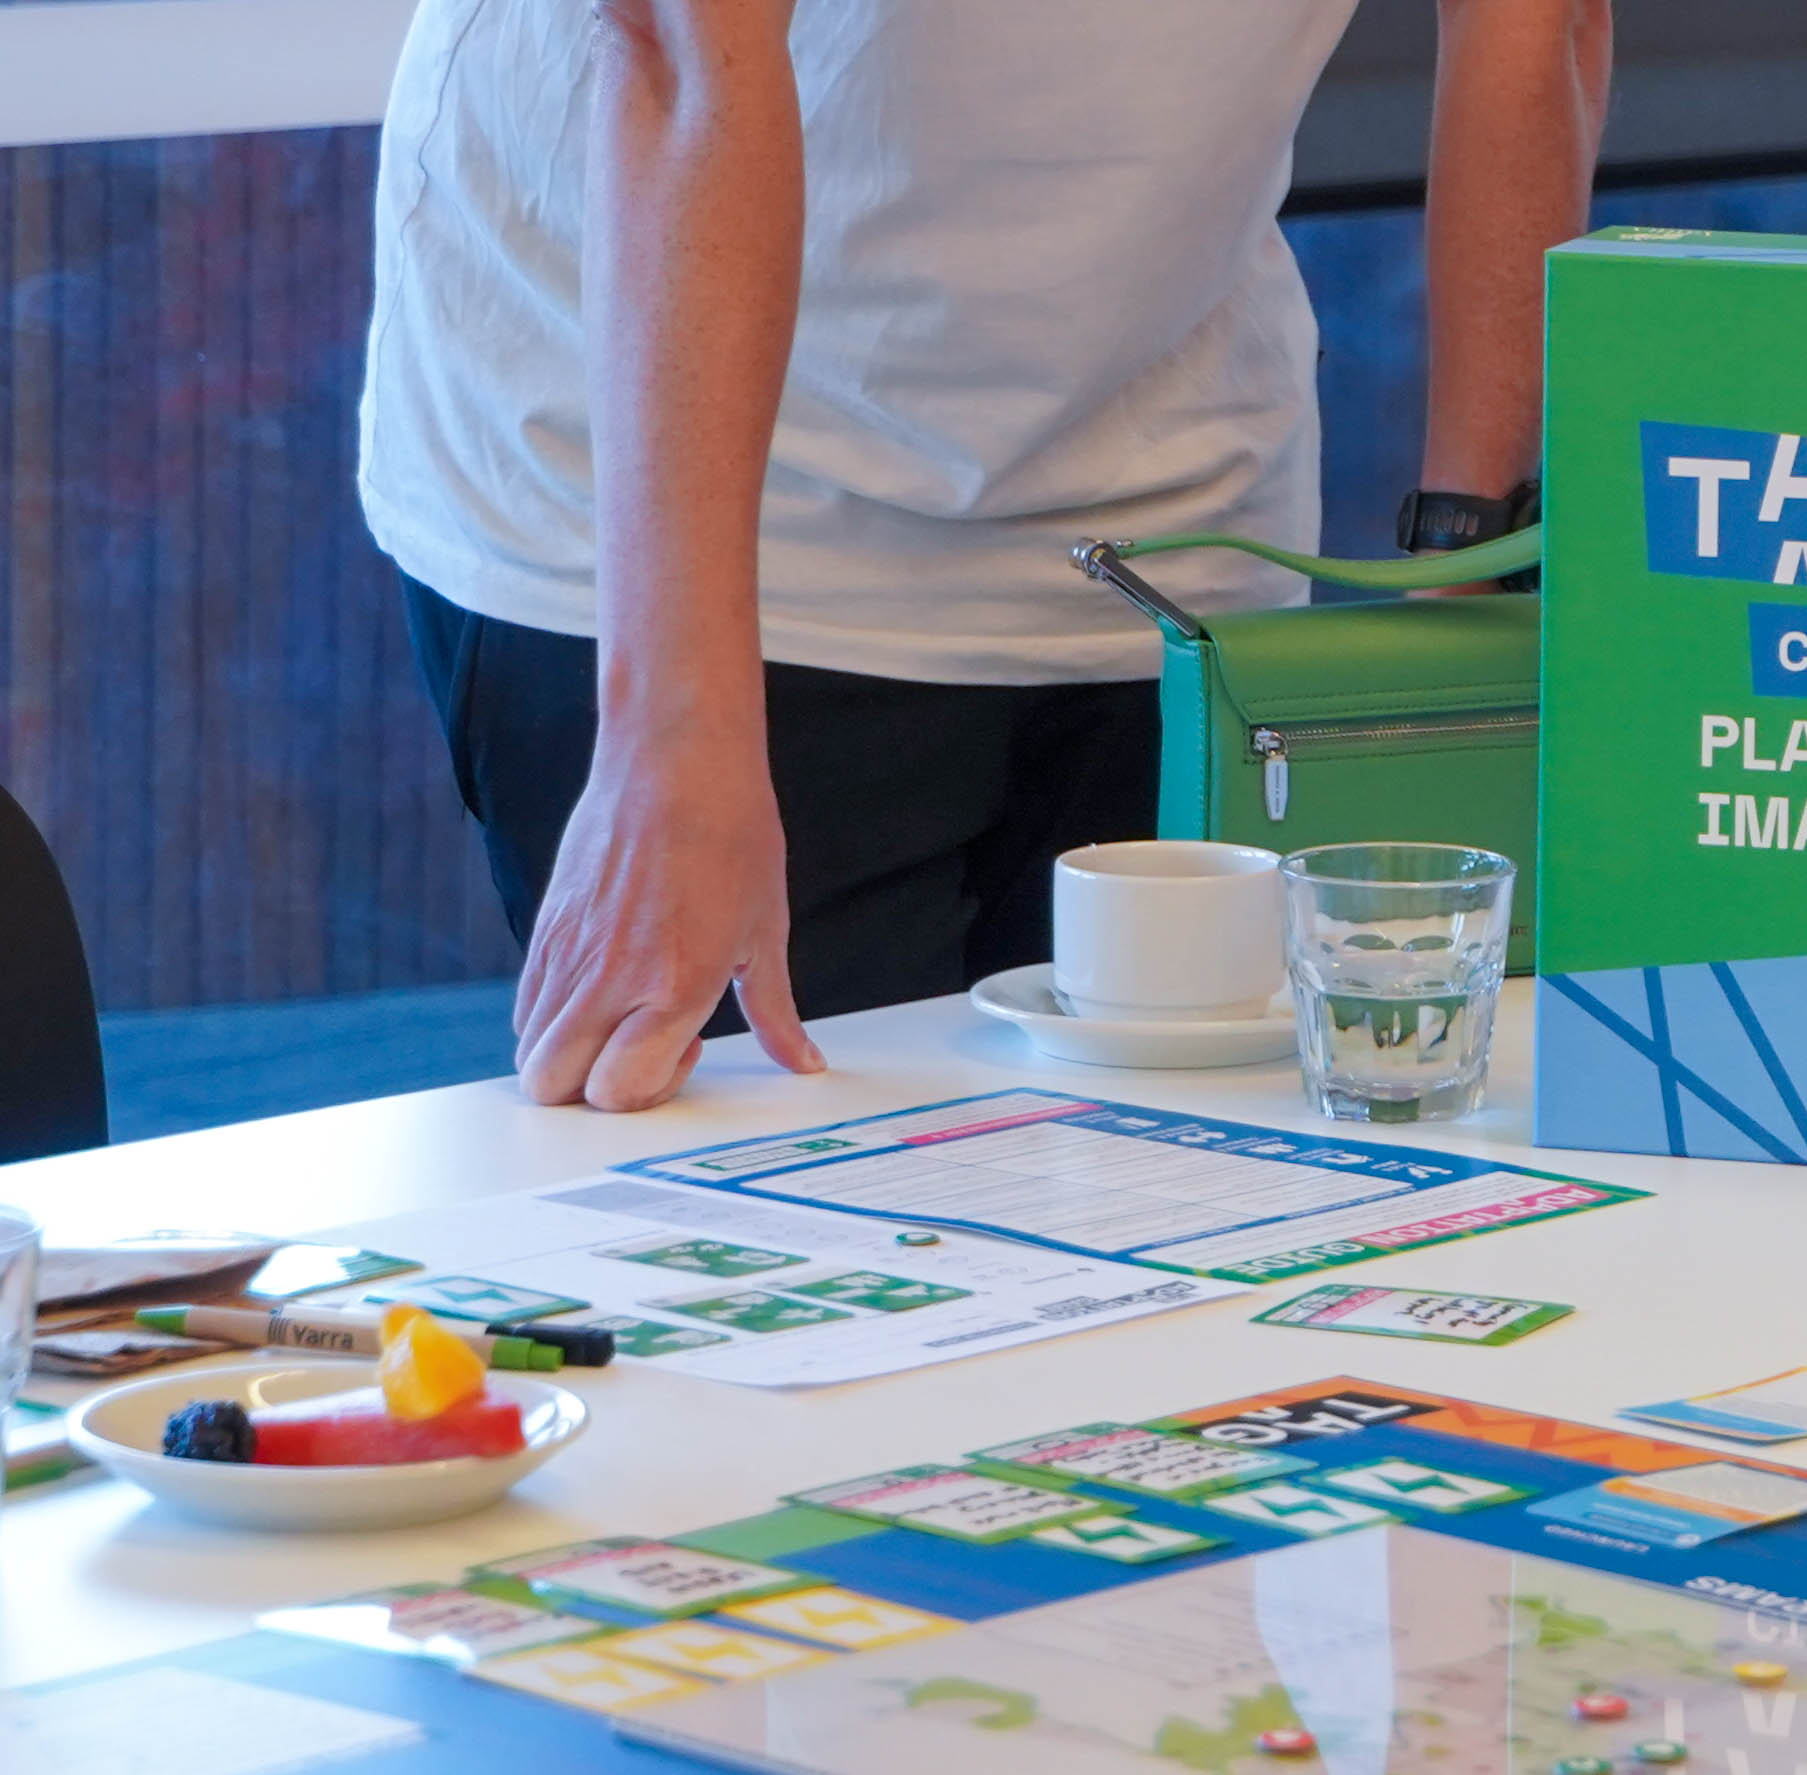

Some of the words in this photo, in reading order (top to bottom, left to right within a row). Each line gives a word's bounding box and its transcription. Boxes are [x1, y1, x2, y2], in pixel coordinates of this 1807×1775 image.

[1360, 1184, 1597, 1247] ADAPTATION
[1226, 1239, 1366, 1276] GUIDE
[292, 1324, 354, 1350] Yarra
[1202, 1397, 1411, 1446] TAG
